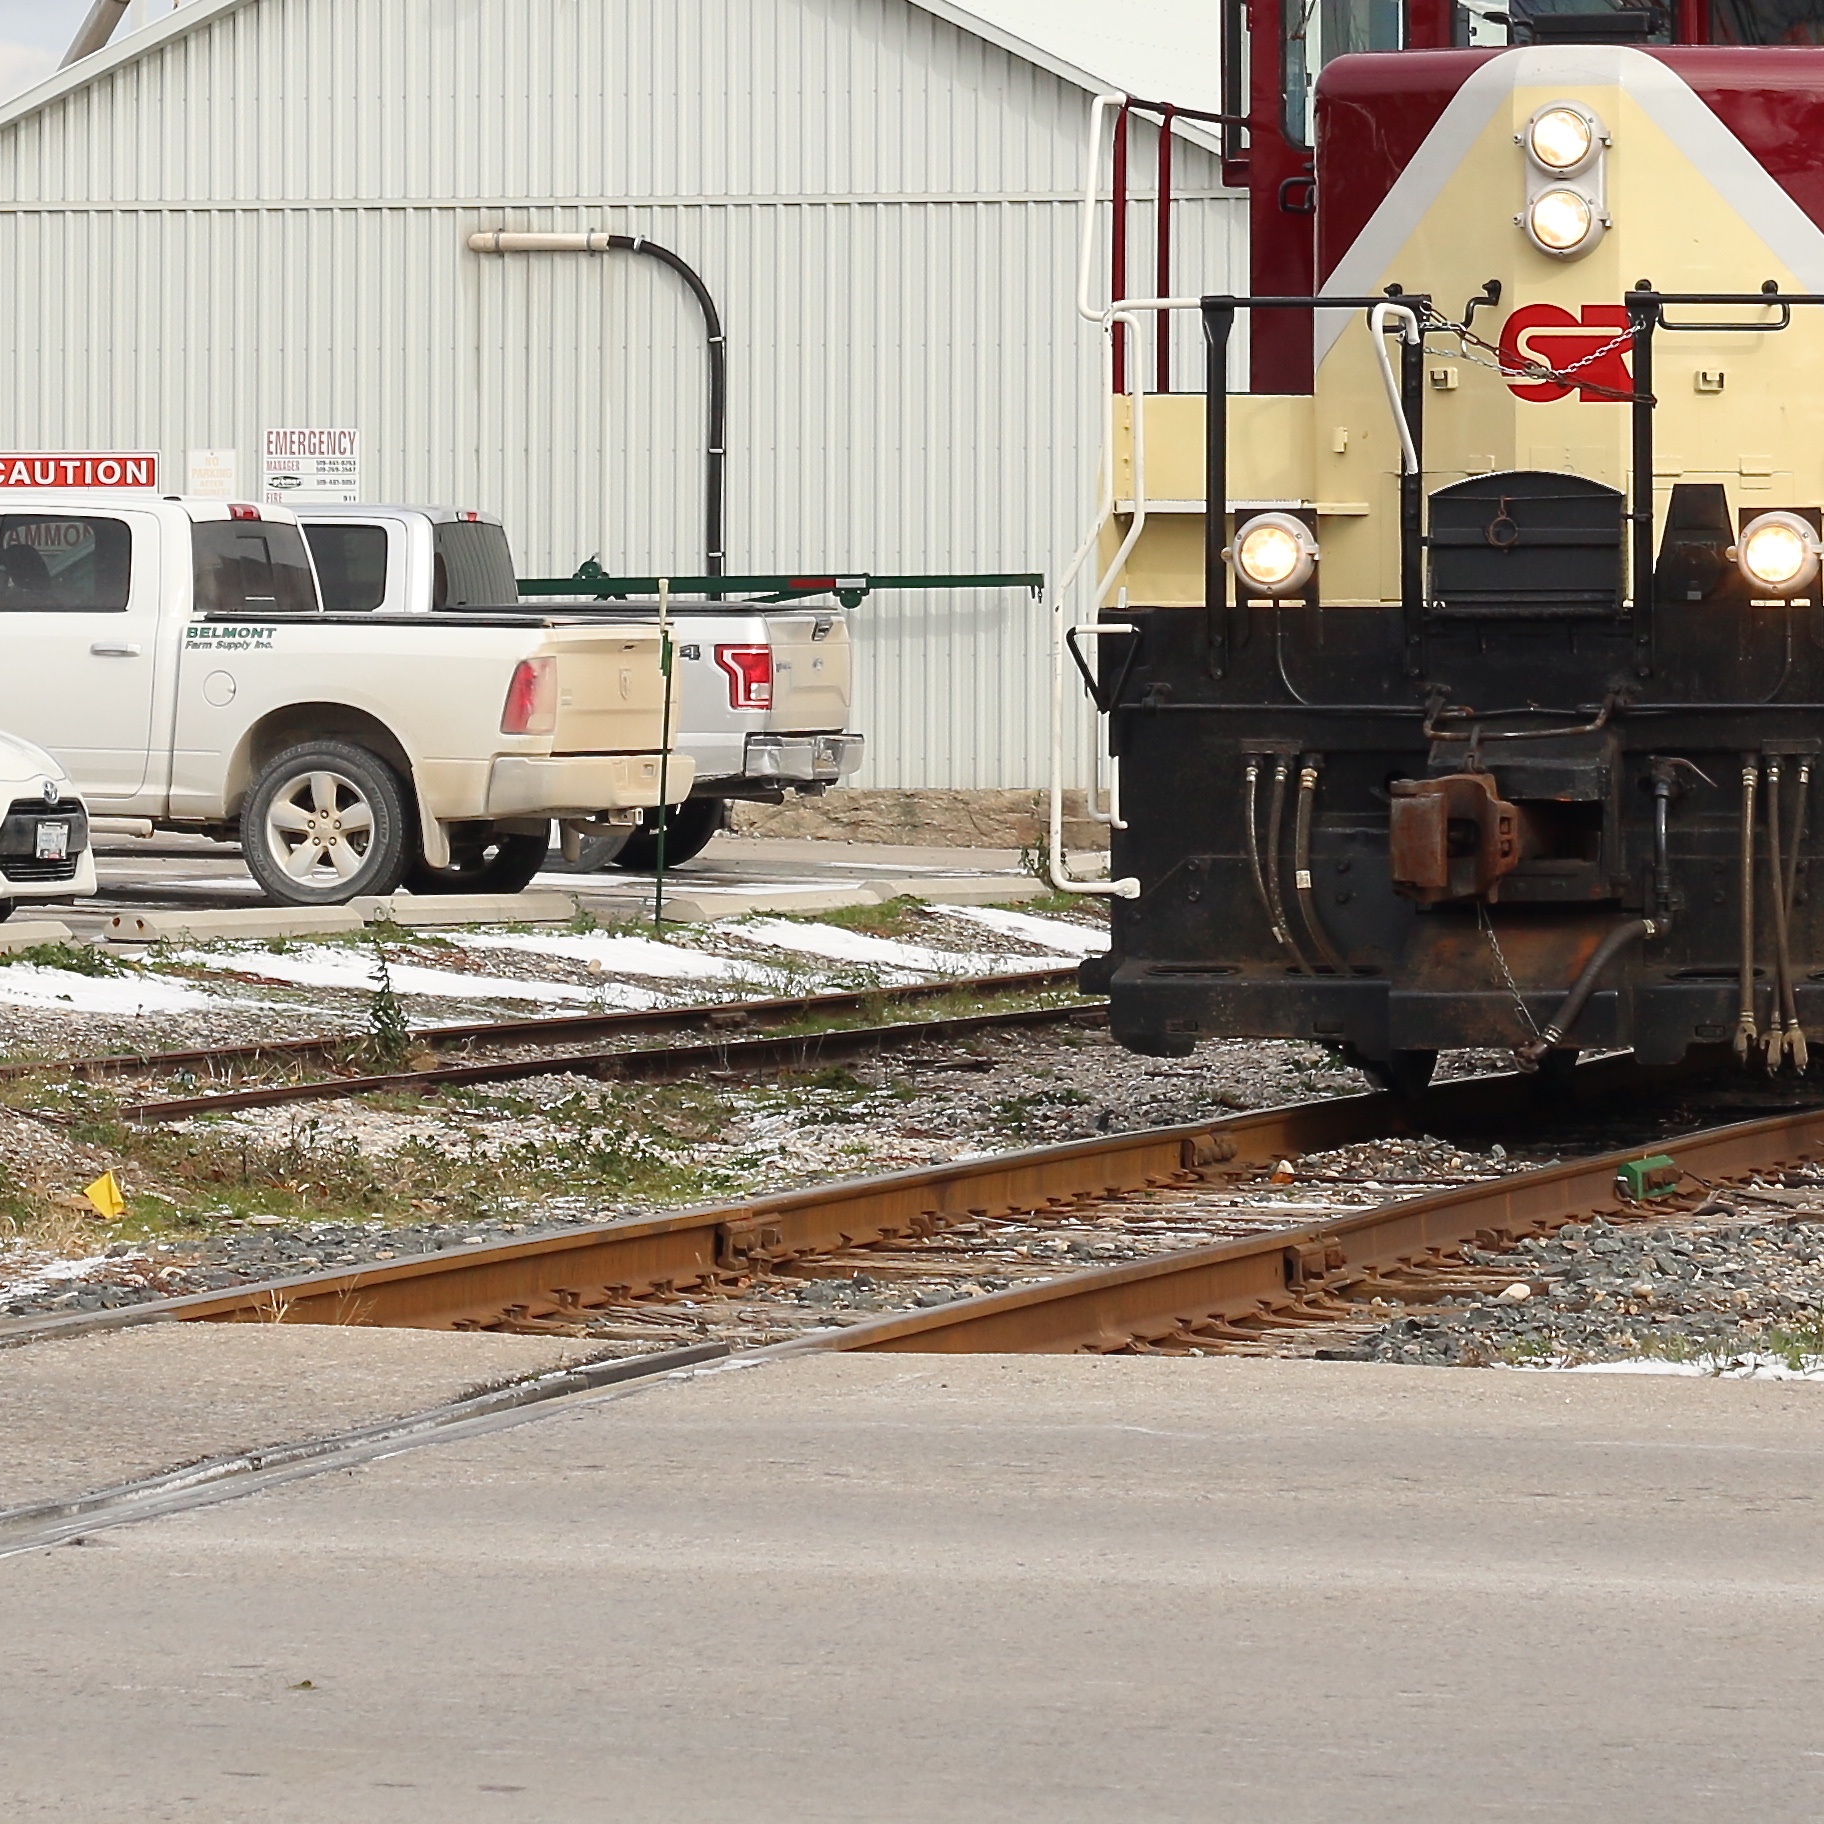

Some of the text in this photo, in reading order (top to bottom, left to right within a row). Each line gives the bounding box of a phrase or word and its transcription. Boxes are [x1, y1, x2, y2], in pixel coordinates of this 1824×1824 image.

[266, 431, 357, 455] EMERGENCY
[266, 461, 300, 471] MANAGER
[266, 492, 283, 503] FIRE
[186, 627, 277, 639] BELMONT
[185, 640, 273, 650] Farm Supply Inc.
